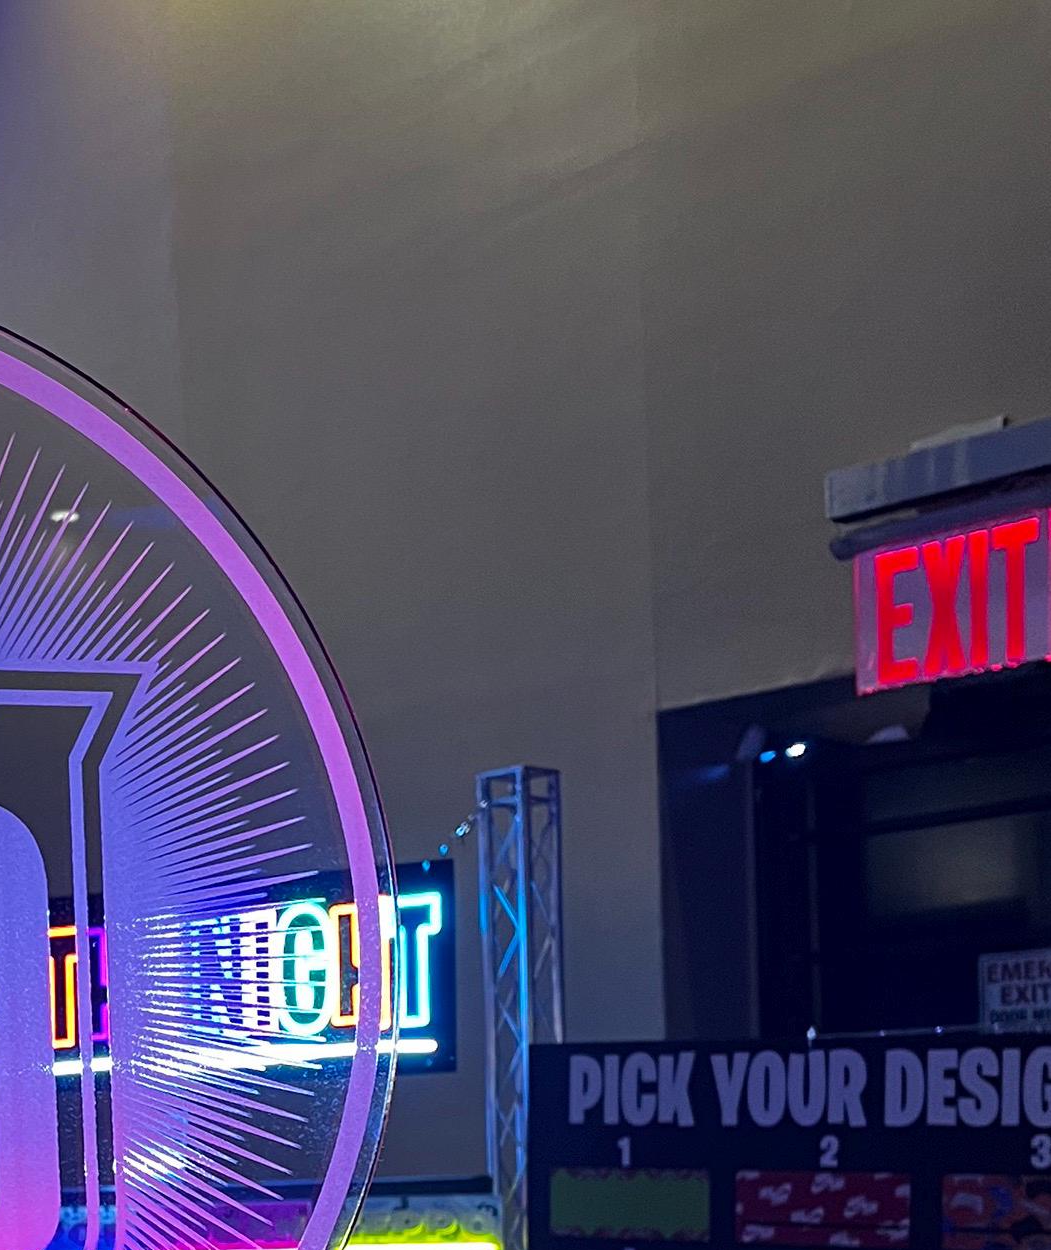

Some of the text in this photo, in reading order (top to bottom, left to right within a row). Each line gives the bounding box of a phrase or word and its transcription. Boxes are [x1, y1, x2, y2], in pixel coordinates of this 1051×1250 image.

[876, 517, 1040, 684] EXIT
[1001, 984, 1051, 1006] EXIT
[568, 1050, 696, 1127] PICK
[710, 1049, 868, 1128] YOUR
[618, 1137, 630, 1166] 1
[820, 1135, 839, 1167] 2
[1031, 1134, 1051, 1168] 3
